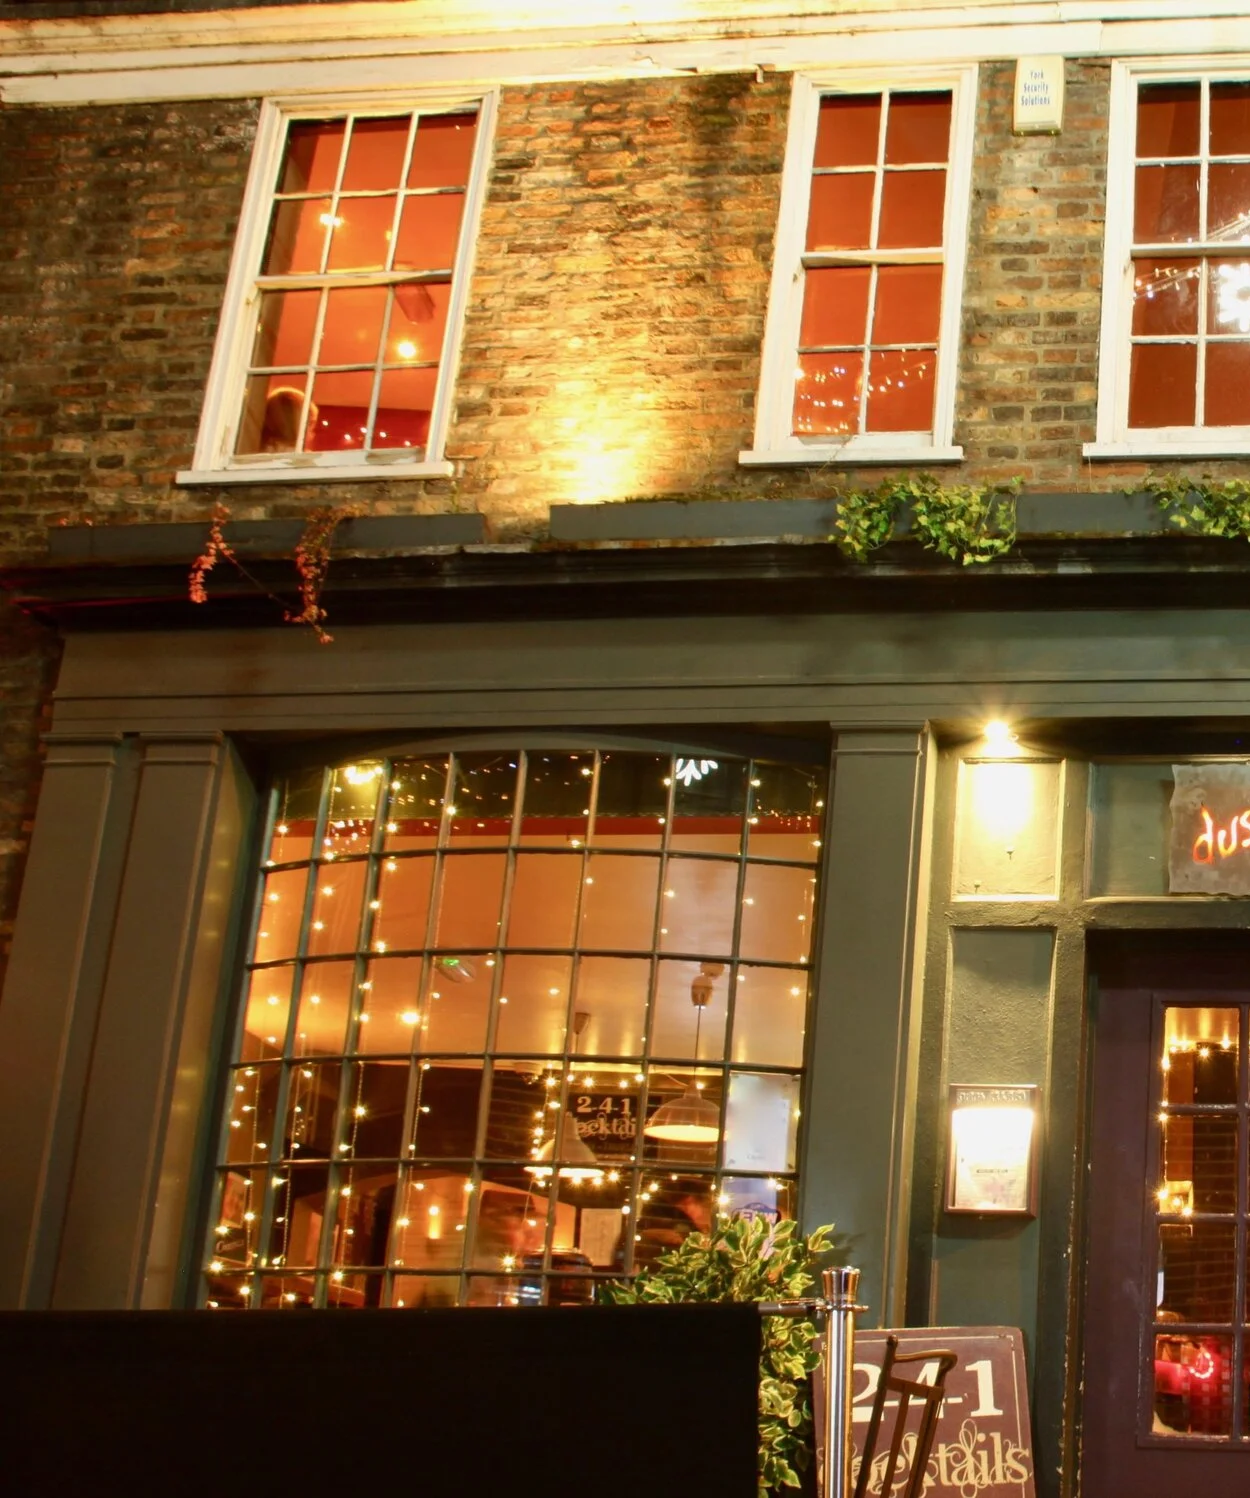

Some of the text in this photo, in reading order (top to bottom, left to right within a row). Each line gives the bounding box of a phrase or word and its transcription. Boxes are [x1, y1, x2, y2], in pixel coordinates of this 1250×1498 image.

[1030, 69, 1044, 80] York
[1023, 82, 1049, 94] Security
[1021, 95, 1051, 106] Solutions
[576, 1095, 631, 1114] 2-4-1
